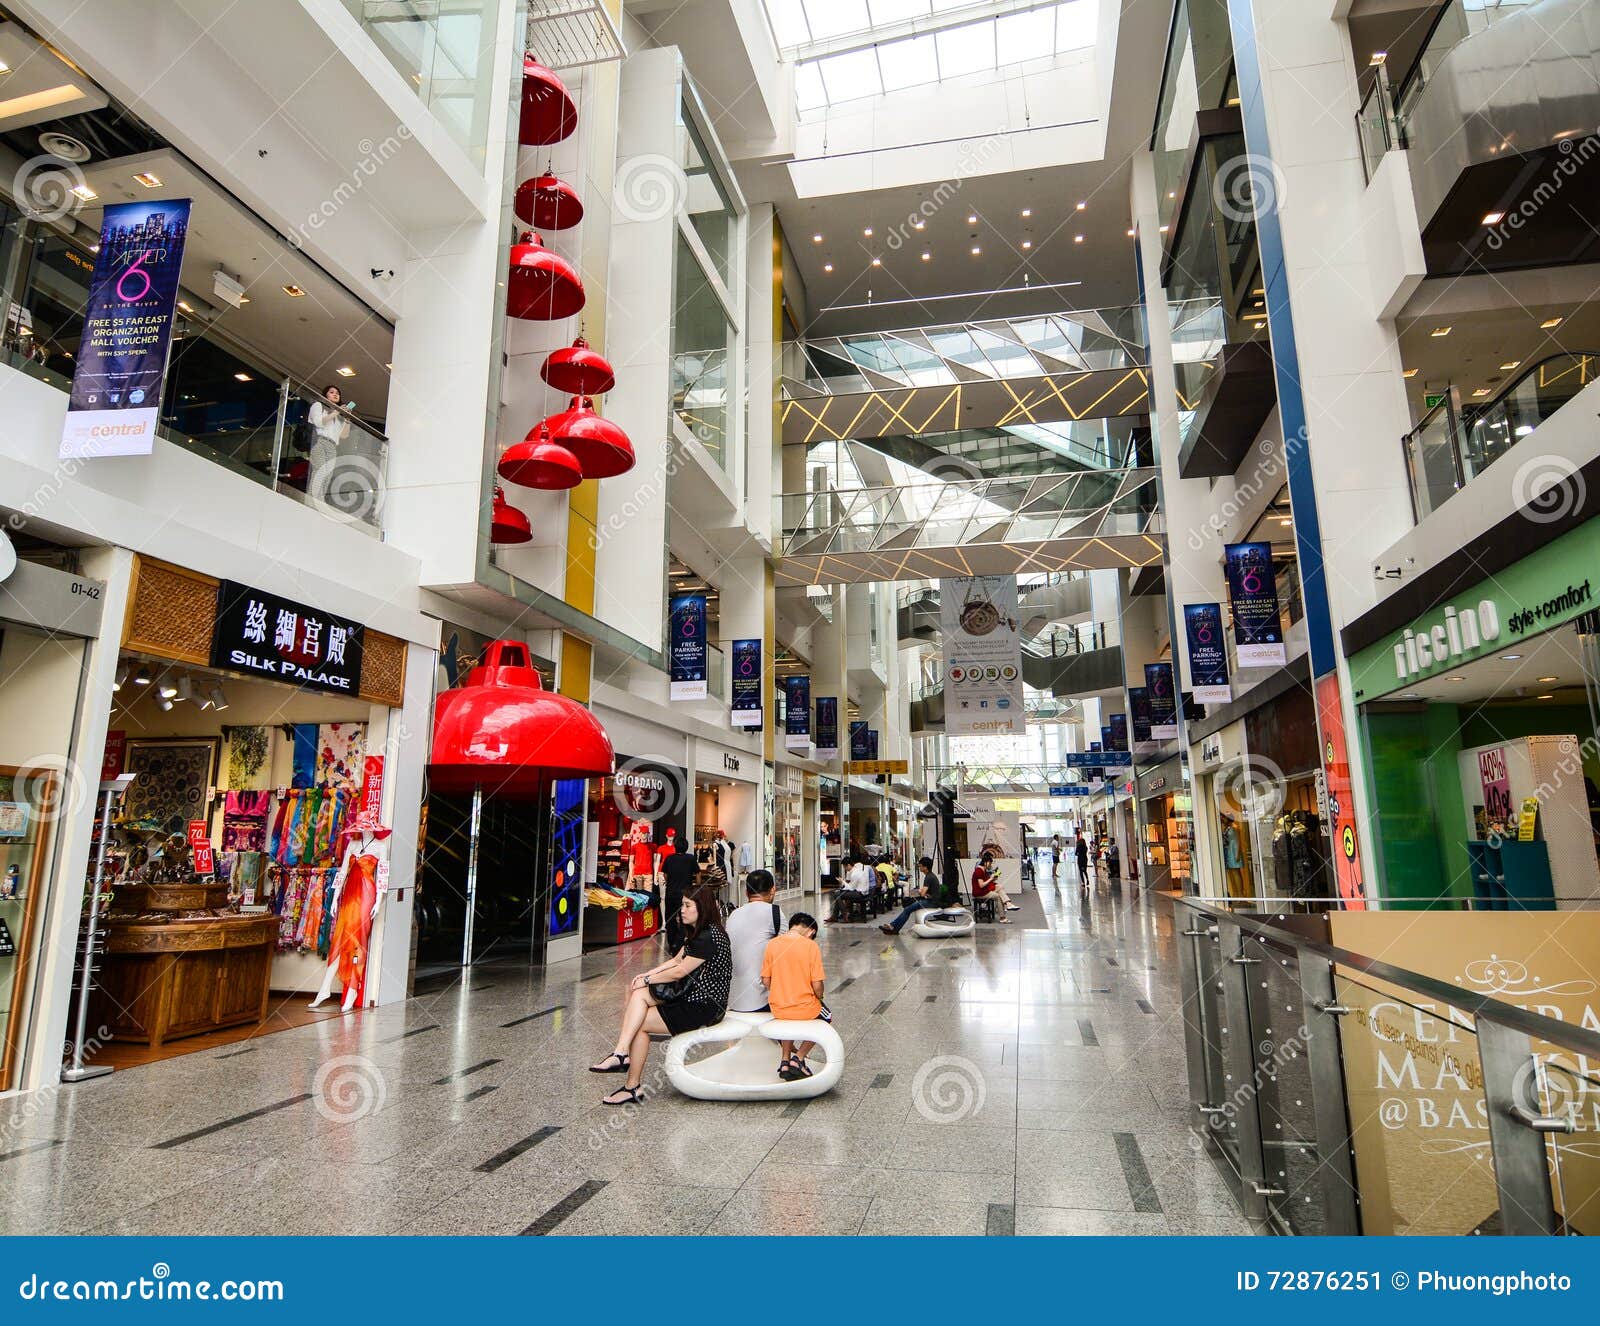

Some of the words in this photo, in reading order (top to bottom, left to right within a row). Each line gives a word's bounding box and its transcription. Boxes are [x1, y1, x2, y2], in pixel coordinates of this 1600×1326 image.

[112, 248, 167, 266] AFTER
[116, 249, 152, 302] 6
[88, 319, 110, 328] FREE
[113, 318, 124, 327] $5
[125, 317, 144, 326] FAR
[145, 315, 168, 324] EAST
[93, 326, 159, 337] ORGANIZATION
[90, 338, 114, 347] MALL
[118, 336, 159, 346] VOUCHER
[91, 420, 148, 437] central
[71, 582, 100, 600] 01-42
[1393, 600, 1500, 679] riccino
[230, 650, 278, 672] SILK
[281, 661, 351, 689] PALACE
[971, 719, 1013, 731] central
[1481, 749, 1505, 783] 40%
[615, 771, 663, 791] GIORDANO
[1374, 1048, 1600, 1093] MAKE
